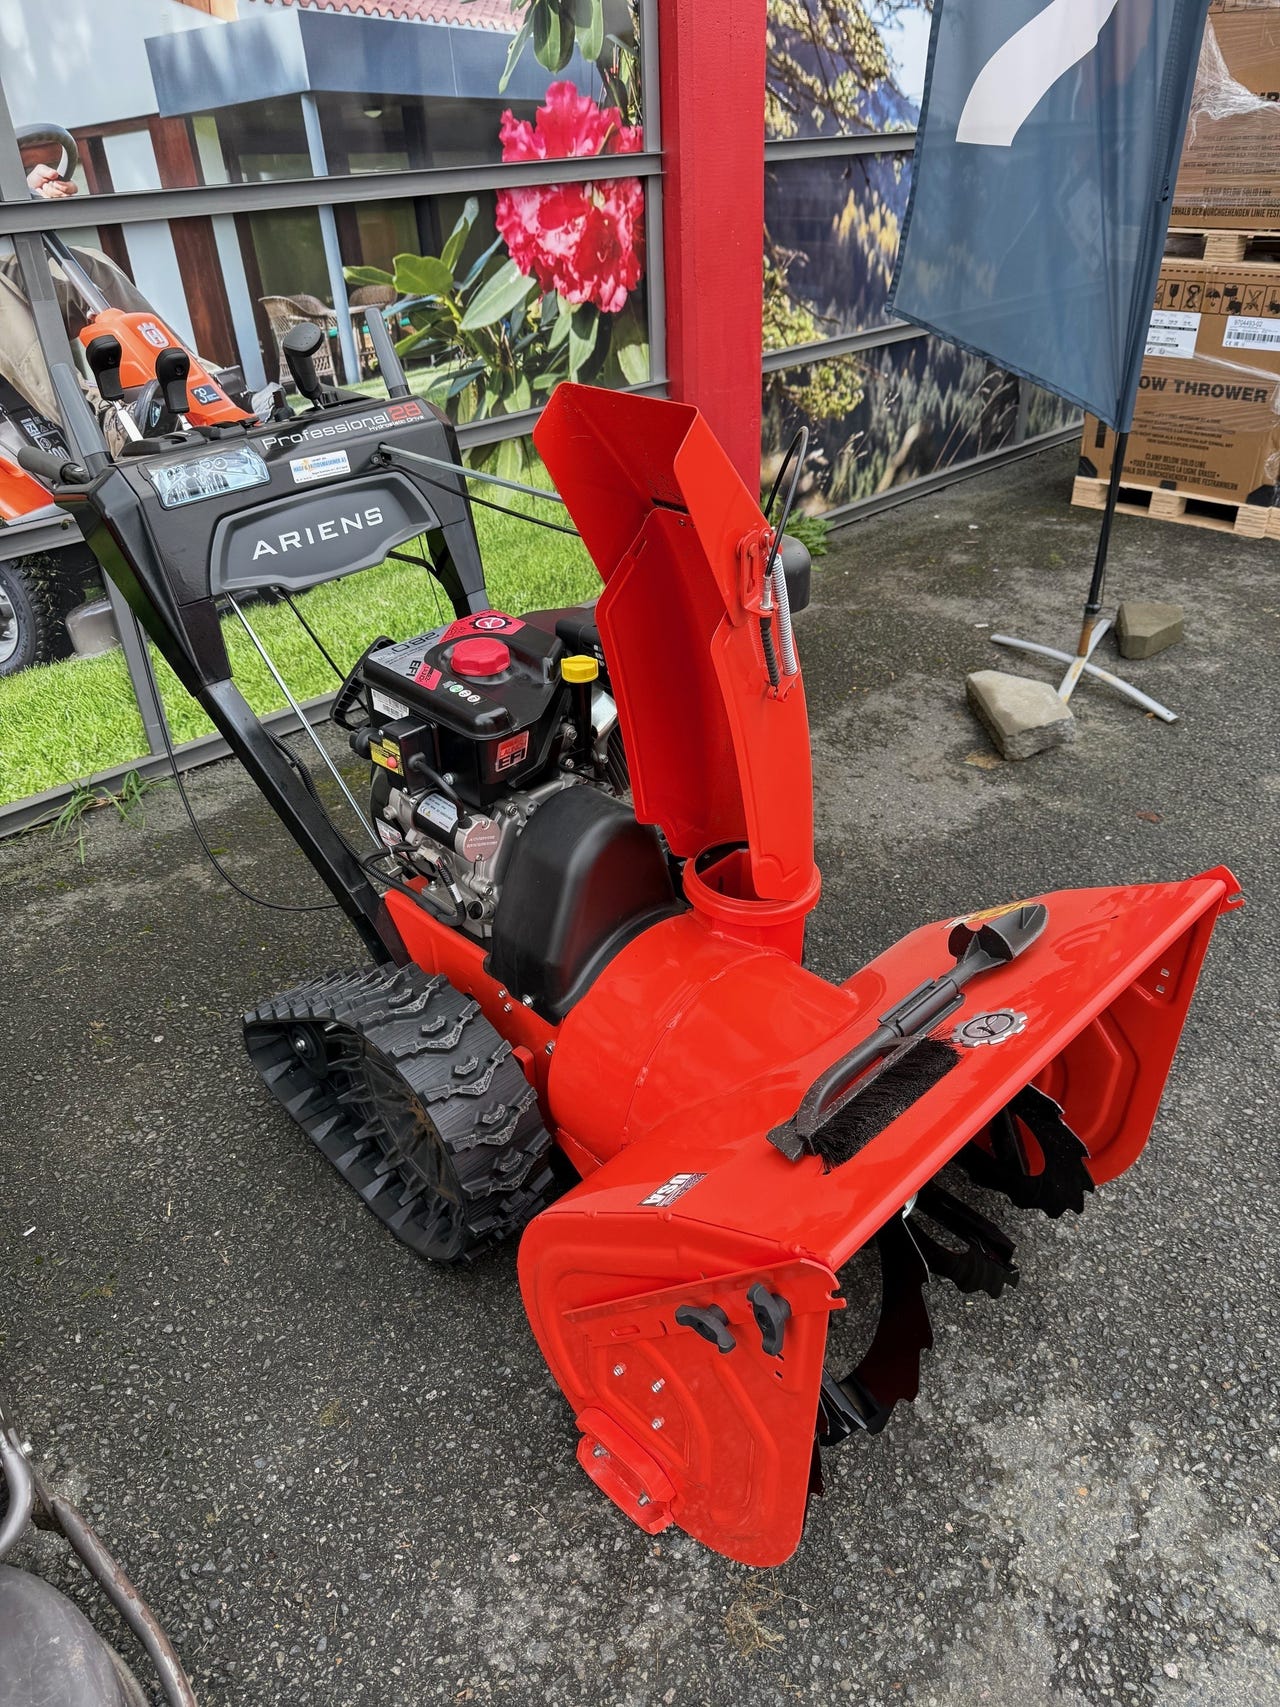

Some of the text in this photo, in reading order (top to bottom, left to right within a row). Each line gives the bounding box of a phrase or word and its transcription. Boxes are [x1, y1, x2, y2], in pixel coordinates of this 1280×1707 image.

[1172, 207, 1190, 216] ERHALB
[1266, 209, 1280, 218] FEST
[1138, 375, 1269, 403] OW THROWER
[261, 401, 422, 450] Professional 28
[252, 507, 384, 560] ARIENS
[405, 659, 422, 677] EFI
[499, 748, 526, 770] EFI
[640, 1173, 693, 1205] USA
